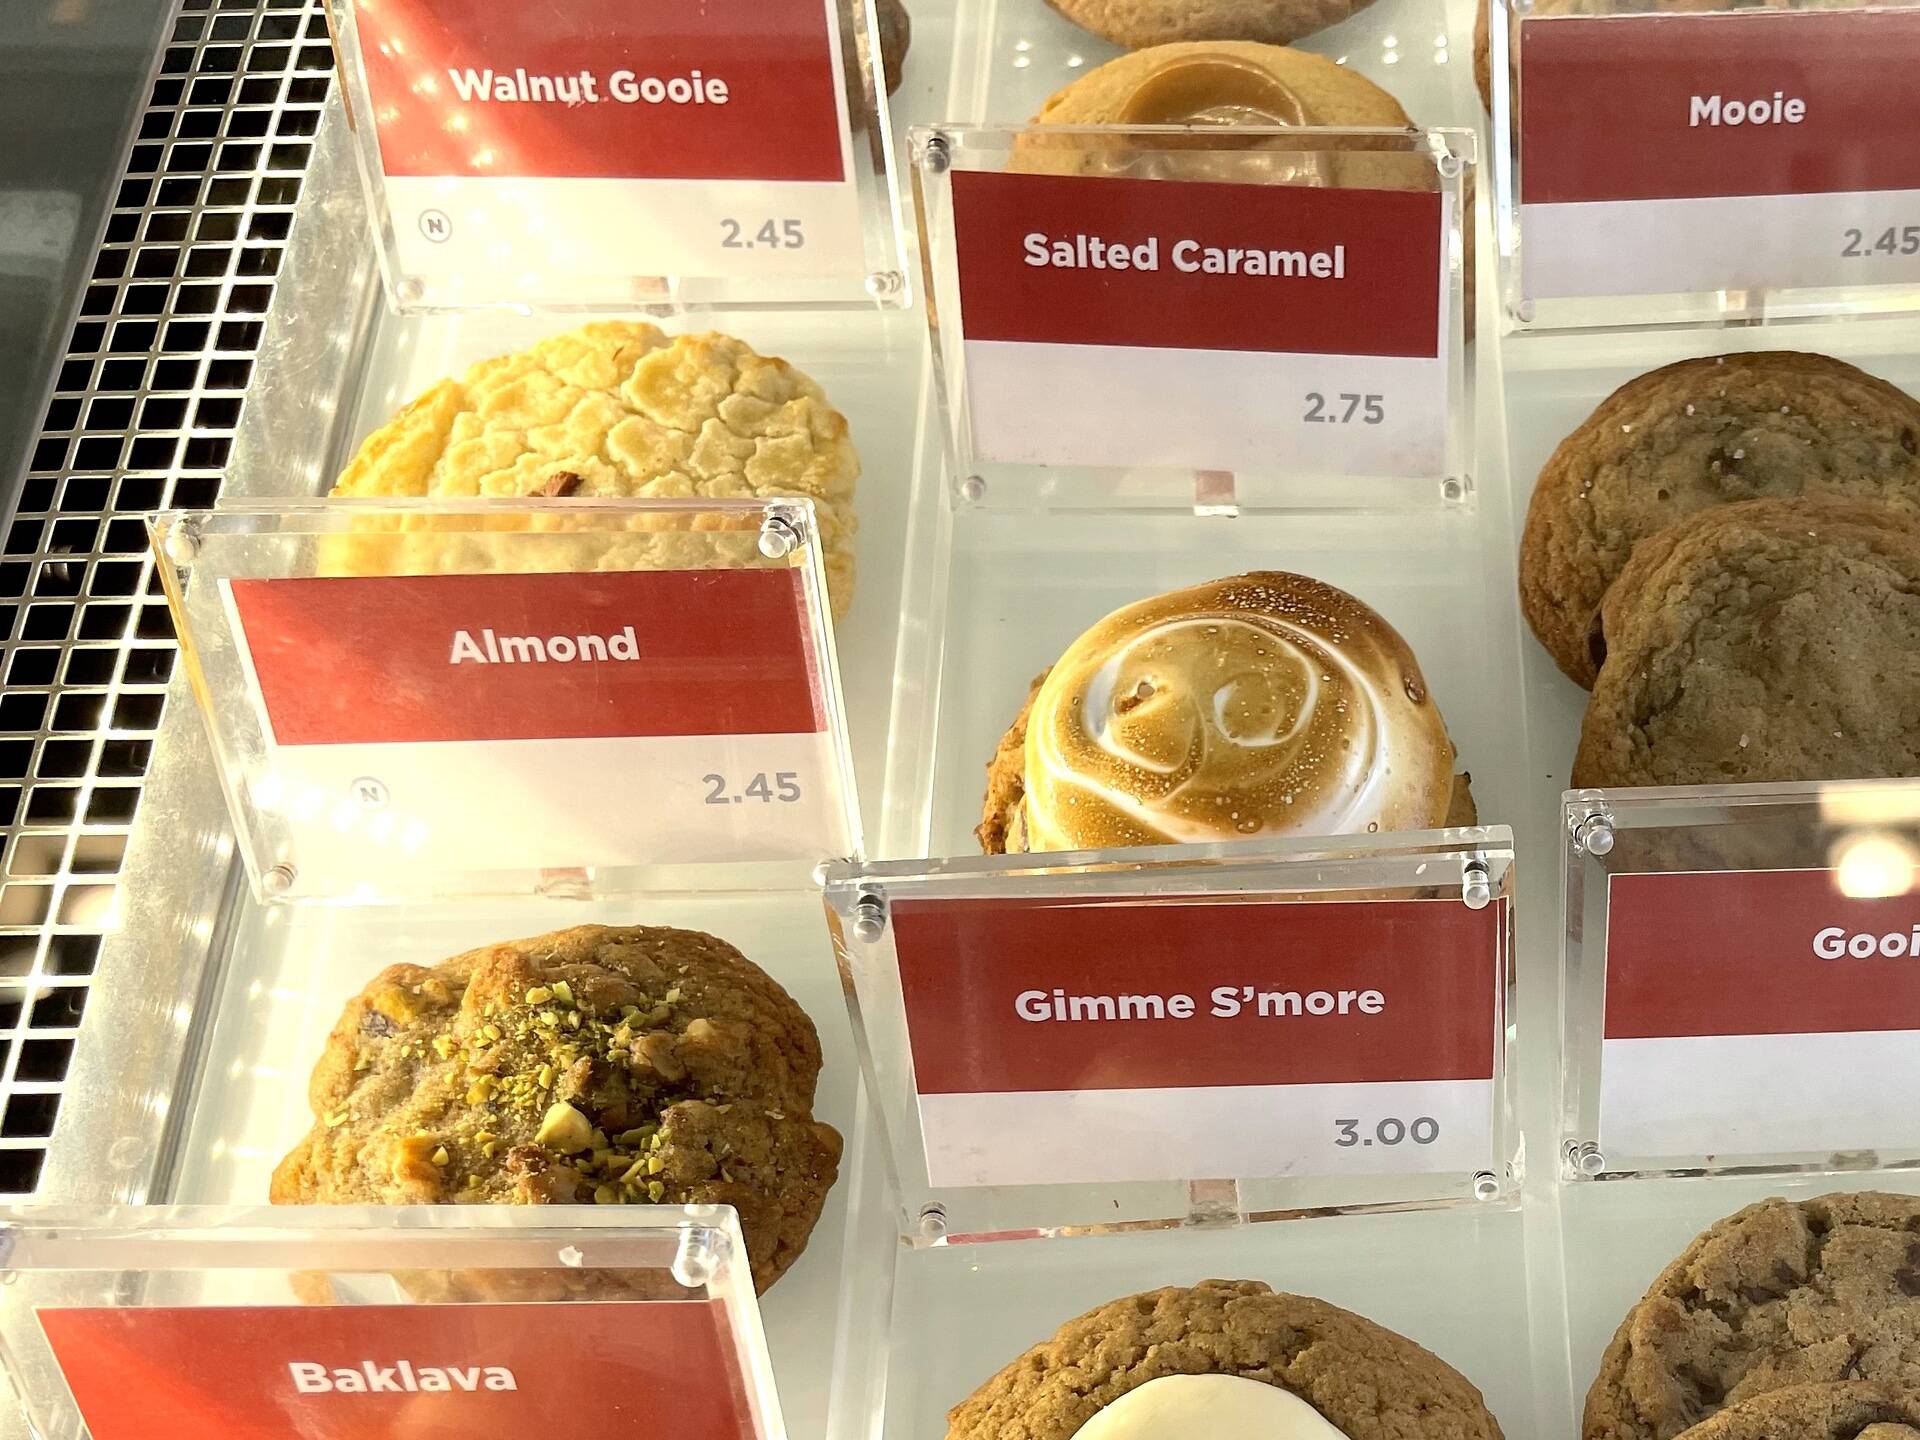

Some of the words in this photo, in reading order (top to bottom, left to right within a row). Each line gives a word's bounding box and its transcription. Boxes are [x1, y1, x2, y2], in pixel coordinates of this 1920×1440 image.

[449, 68, 599, 103] Walnut
[609, 70, 729, 105] Gooie
[1689, 91, 1807, 127] Mooie
[720, 218, 805, 250] 2.45
[1841, 225, 1920, 257] 2.45
[1023, 232, 1159, 271] Salted
[1171, 239, 1346, 279] Caramel
[1303, 392, 1385, 425] 2.75
[449, 625, 641, 665] Almond
[702, 771, 802, 804] 2.45
[1014, 988, 1196, 1023] Gimme
[1209, 985, 1386, 1019] S’more
[1334, 1116, 1441, 1147] 3.00
[288, 1359, 518, 1395] Baklava
